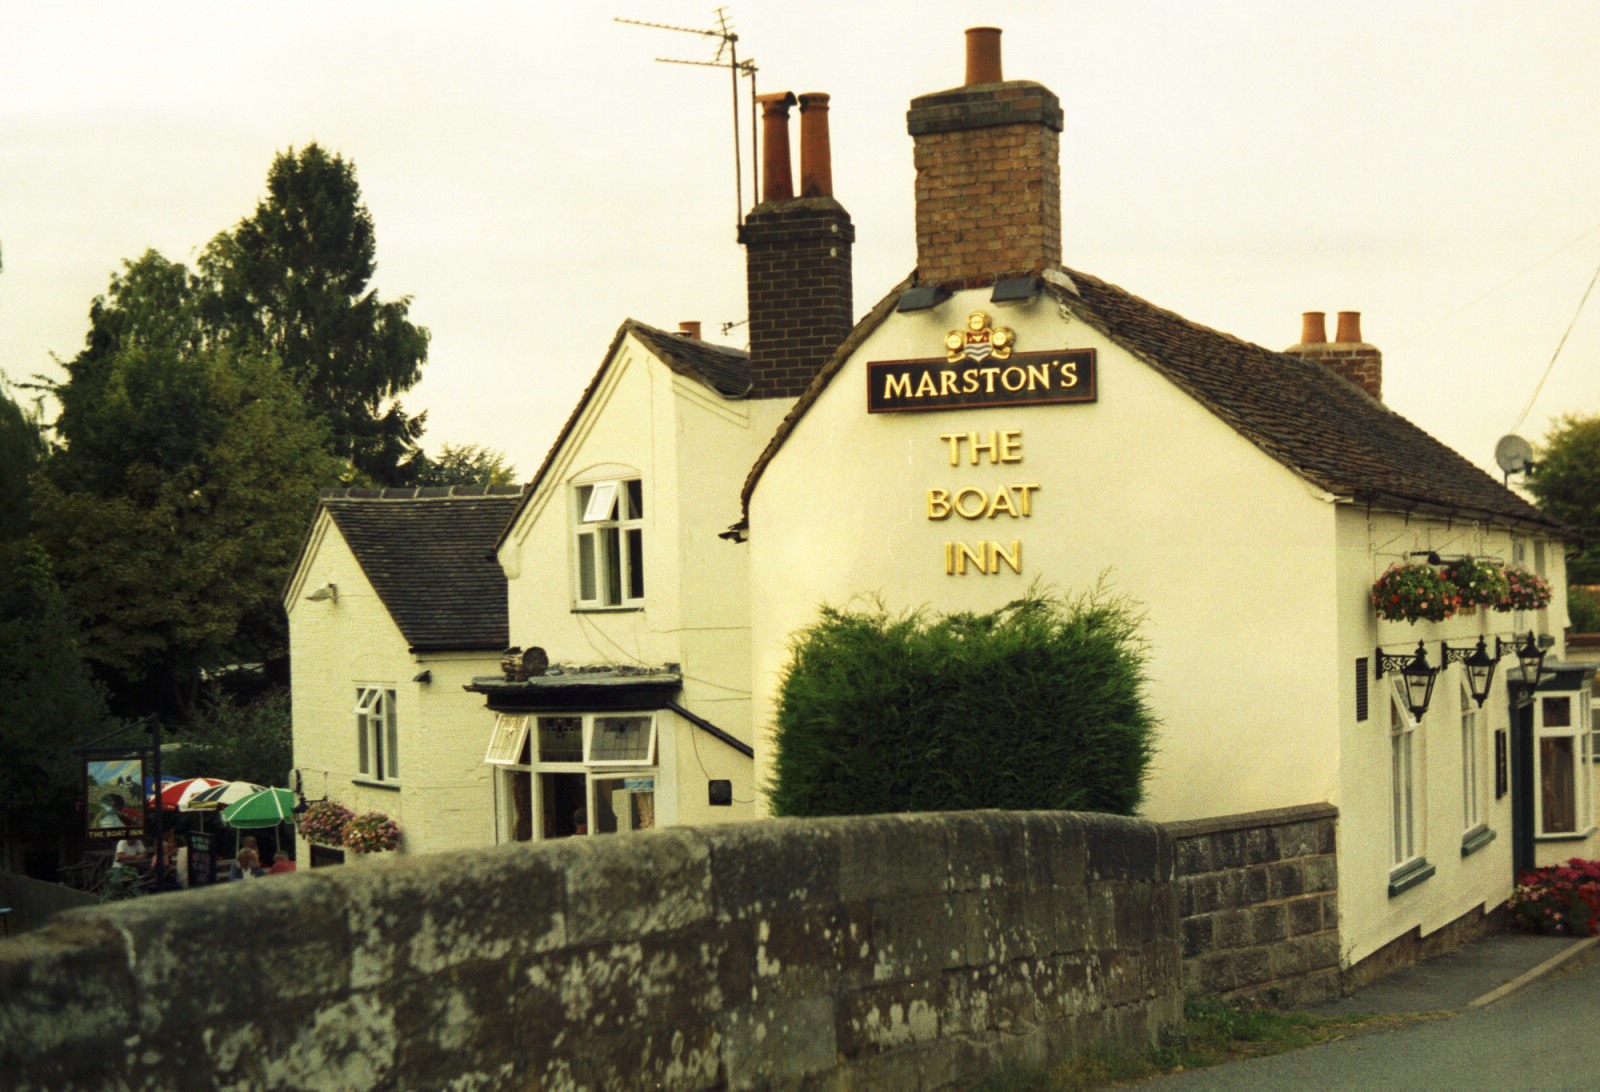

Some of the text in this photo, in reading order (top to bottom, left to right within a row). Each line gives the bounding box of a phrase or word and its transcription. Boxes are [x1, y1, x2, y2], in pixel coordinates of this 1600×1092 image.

[883, 361, 1078, 400] MARSTON'S
[940, 430, 1022, 466] THE
[926, 483, 1040, 520] BOAT
[945, 540, 1022, 574] INN
